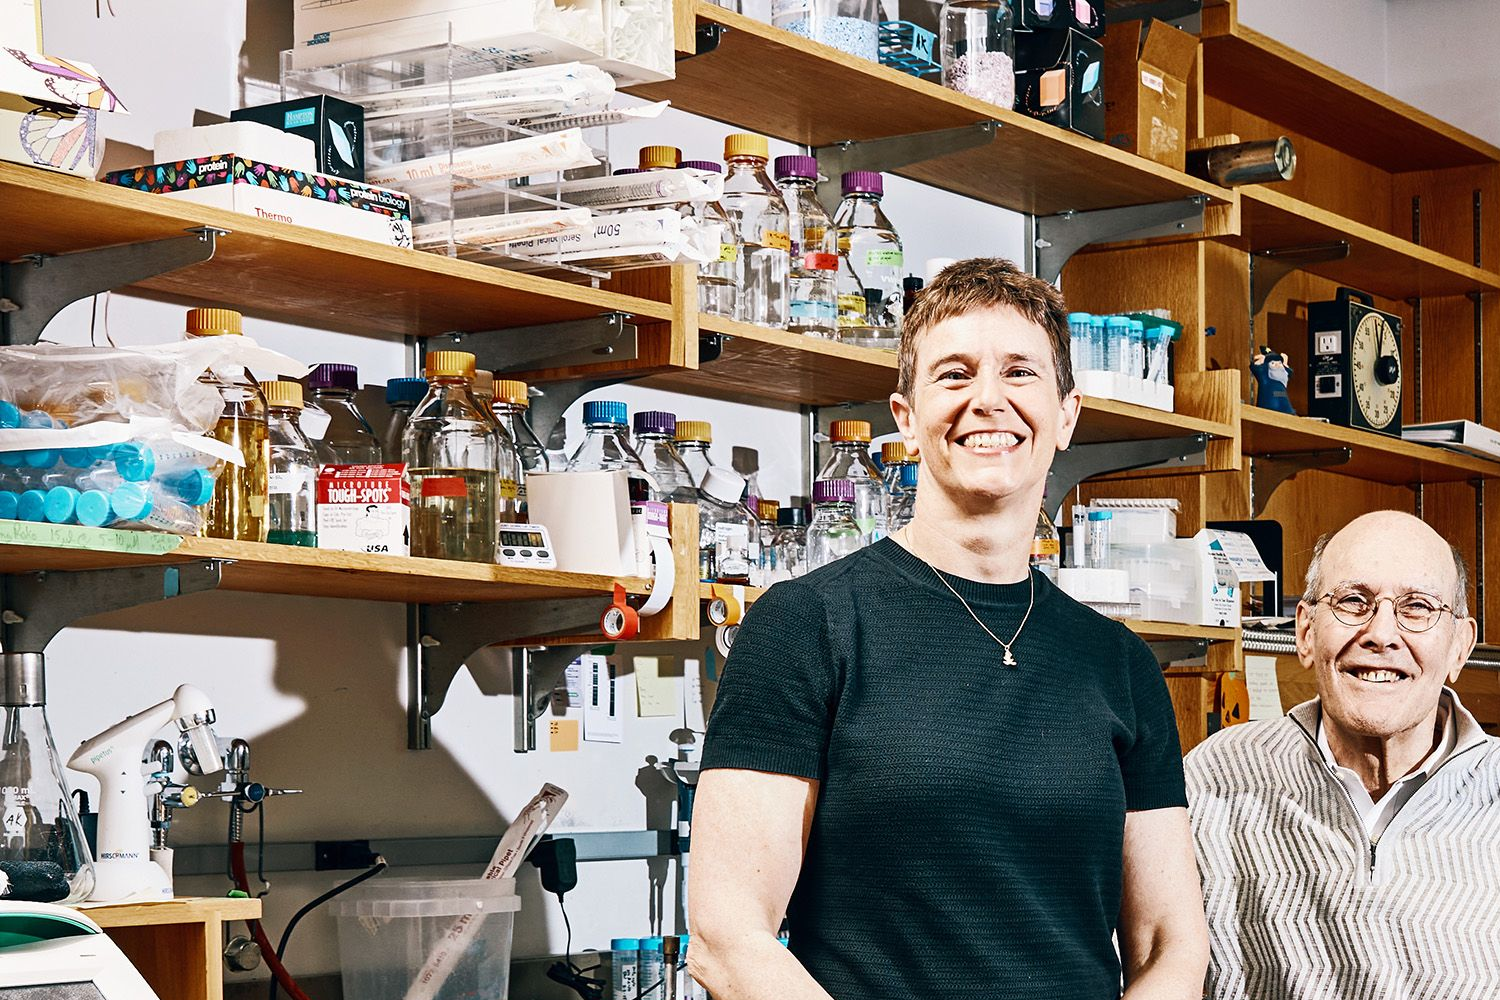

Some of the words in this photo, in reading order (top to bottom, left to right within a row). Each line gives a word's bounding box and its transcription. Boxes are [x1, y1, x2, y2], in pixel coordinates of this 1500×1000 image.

[198, 160, 228, 175] protein
[350, 189, 379, 203] protein
[378, 192, 407, 209] biology
[254, 207, 293, 224] Thermo
[366, 544, 389, 553] USA
